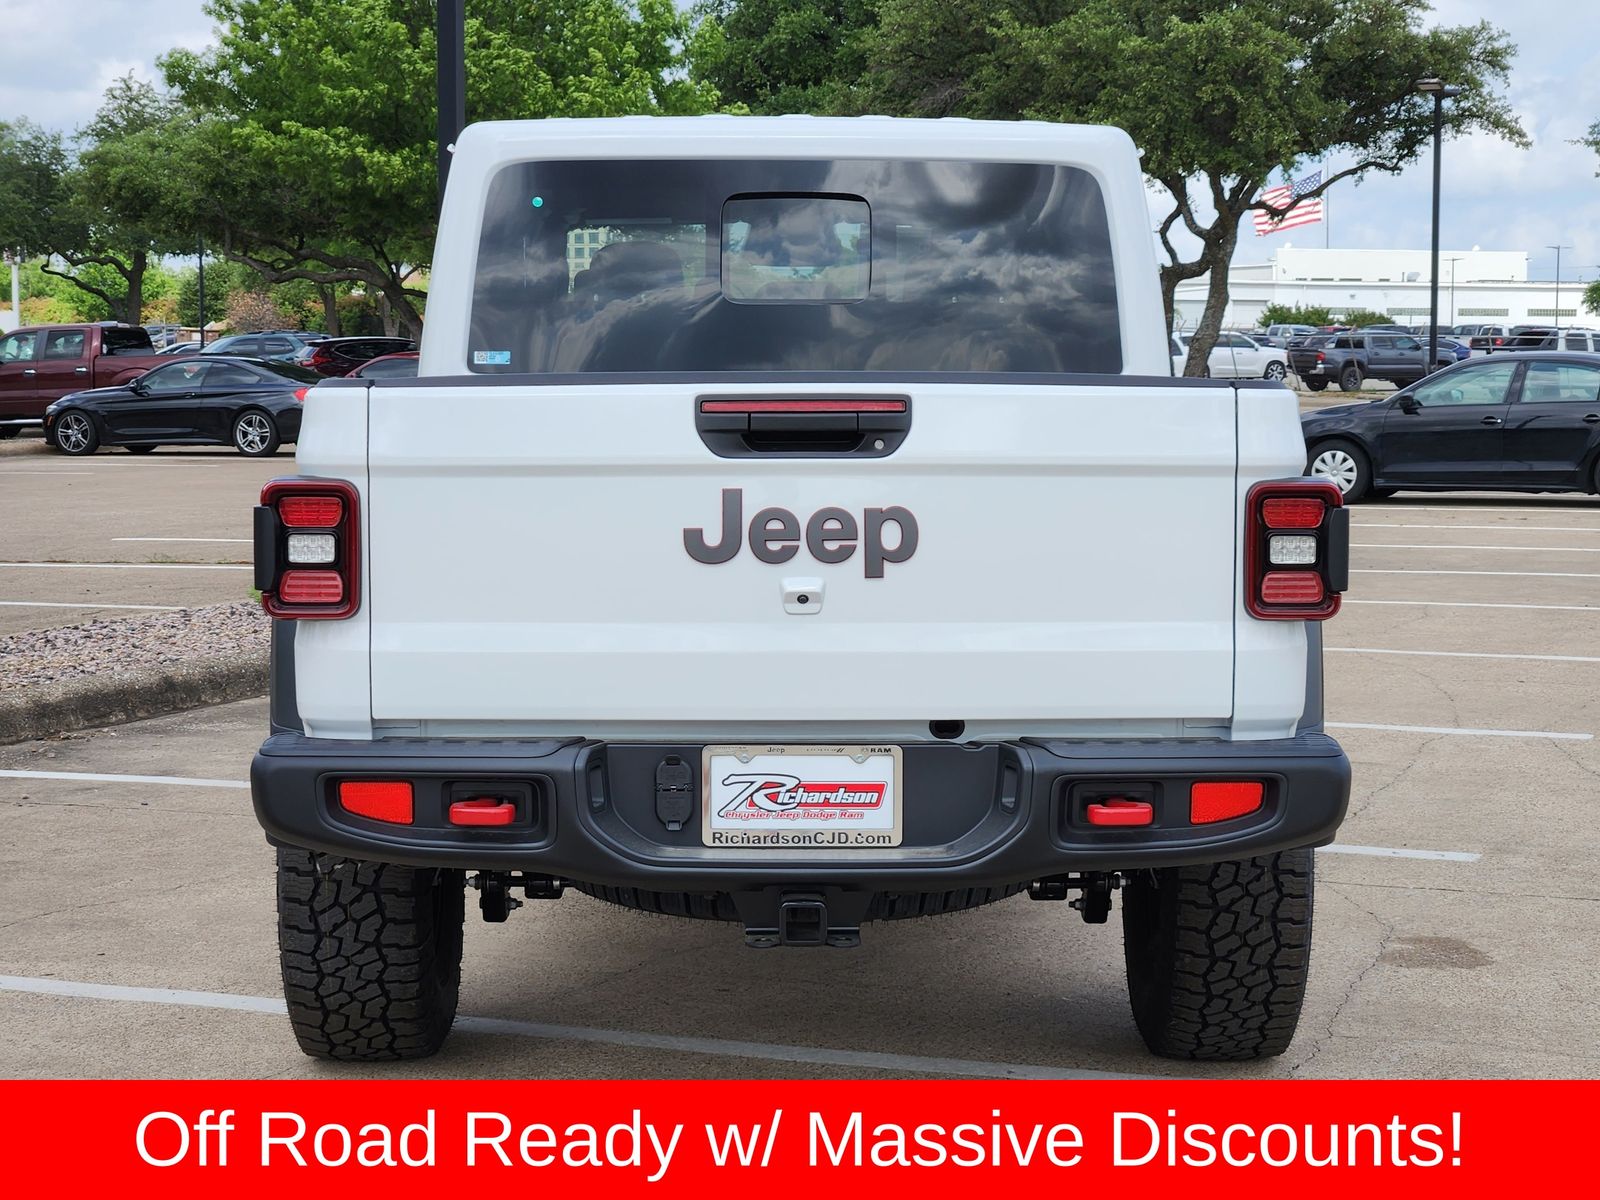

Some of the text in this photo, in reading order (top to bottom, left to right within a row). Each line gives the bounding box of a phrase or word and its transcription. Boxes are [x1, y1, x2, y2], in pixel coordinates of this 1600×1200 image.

[683, 488, 919, 580] Jeep
[717, 773, 879, 818] Richardson
[724, 810, 864, 821] Chrysler Jeep Dodge Ram
[712, 831, 892, 845] RichardsonCJD.com
